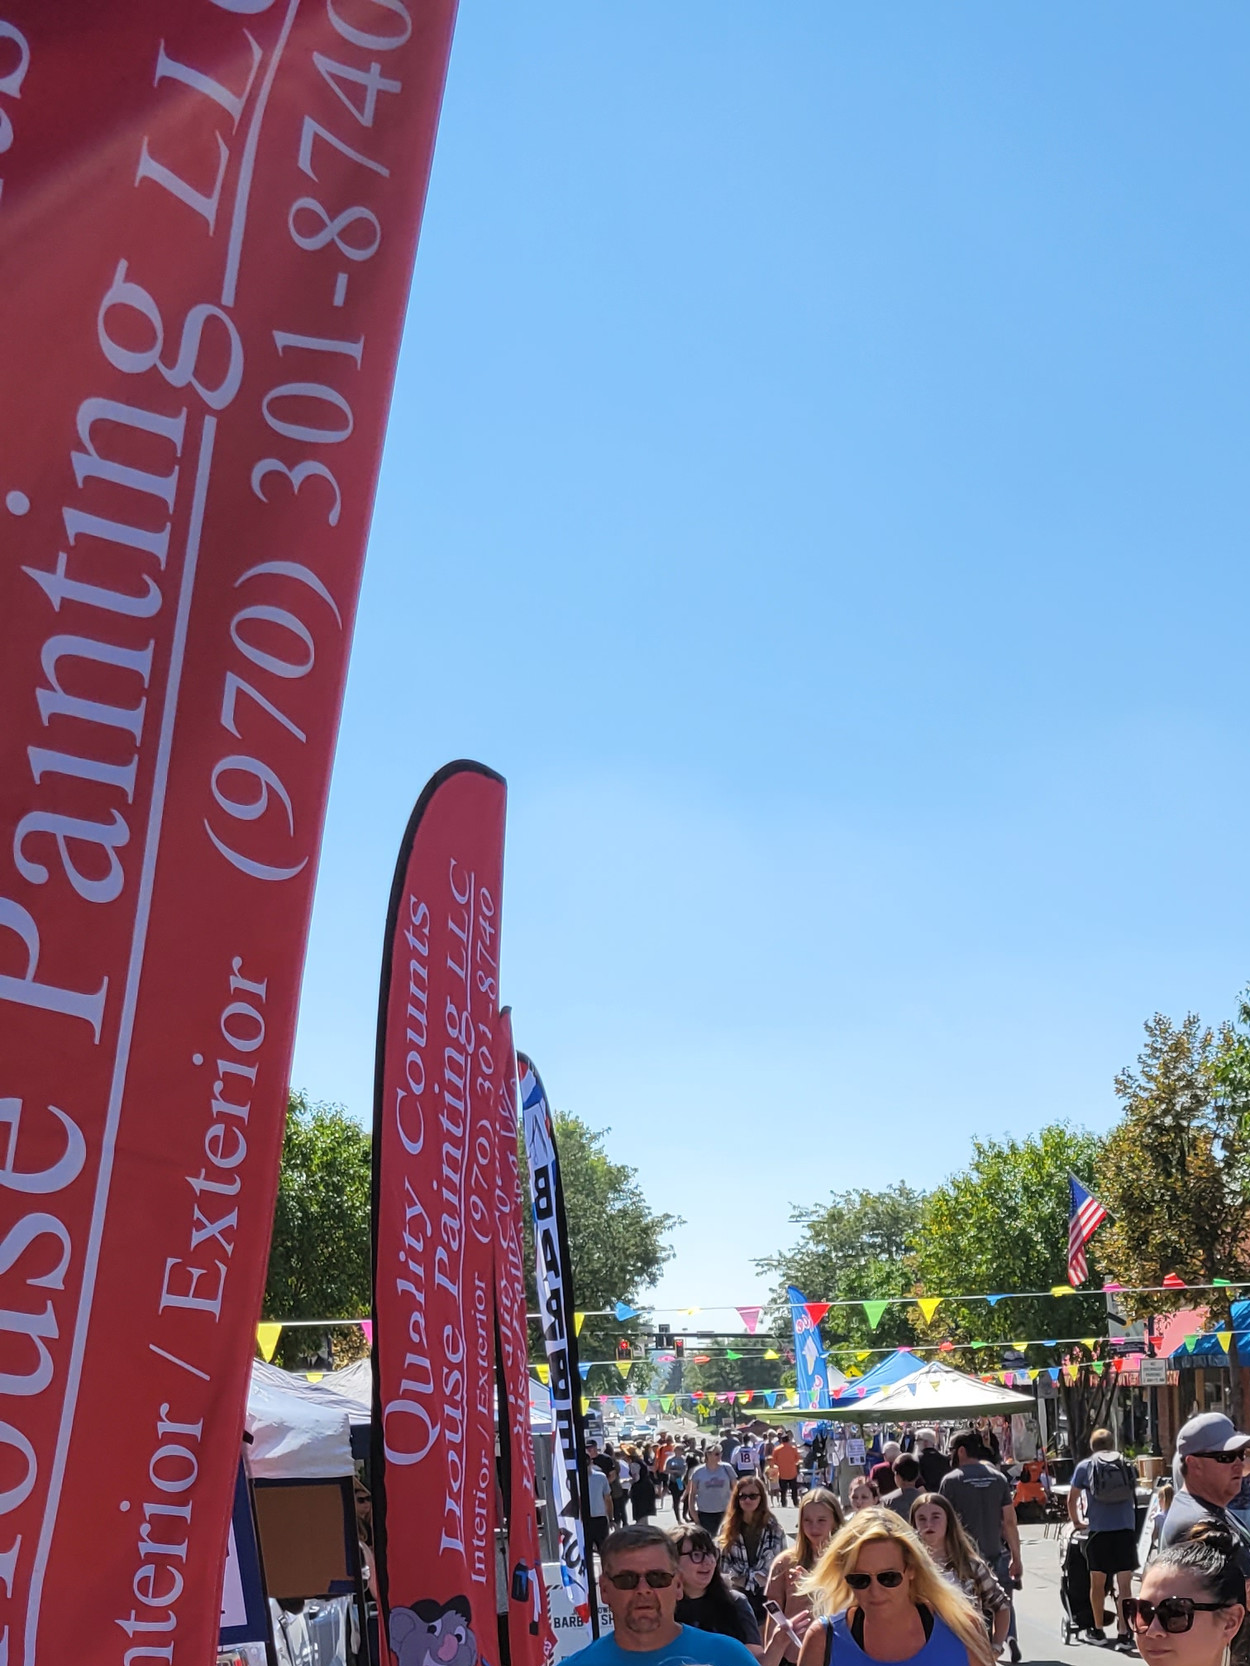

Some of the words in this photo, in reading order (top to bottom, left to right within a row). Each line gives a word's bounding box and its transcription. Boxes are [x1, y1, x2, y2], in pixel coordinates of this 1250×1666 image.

[135, 0, 298, 237] LL
[205, 562, 342, 881] (970)
[396, 894, 430, 1155] Counts
[447, 857, 472, 981] LLC
[476, 886, 498, 1107] 301-8740
[158, 955, 269, 1322] Exterior
[434, 995, 475, 1306] Painting
[470, 1119, 493, 1245] (970)
[383, 1176, 440, 1466] Quality
[471, 1272, 488, 1421] Exterior
[440, 1324, 467, 1562] House
[471, 1450, 491, 1585] Interior
[740, 1452, 751, 1463] 18
